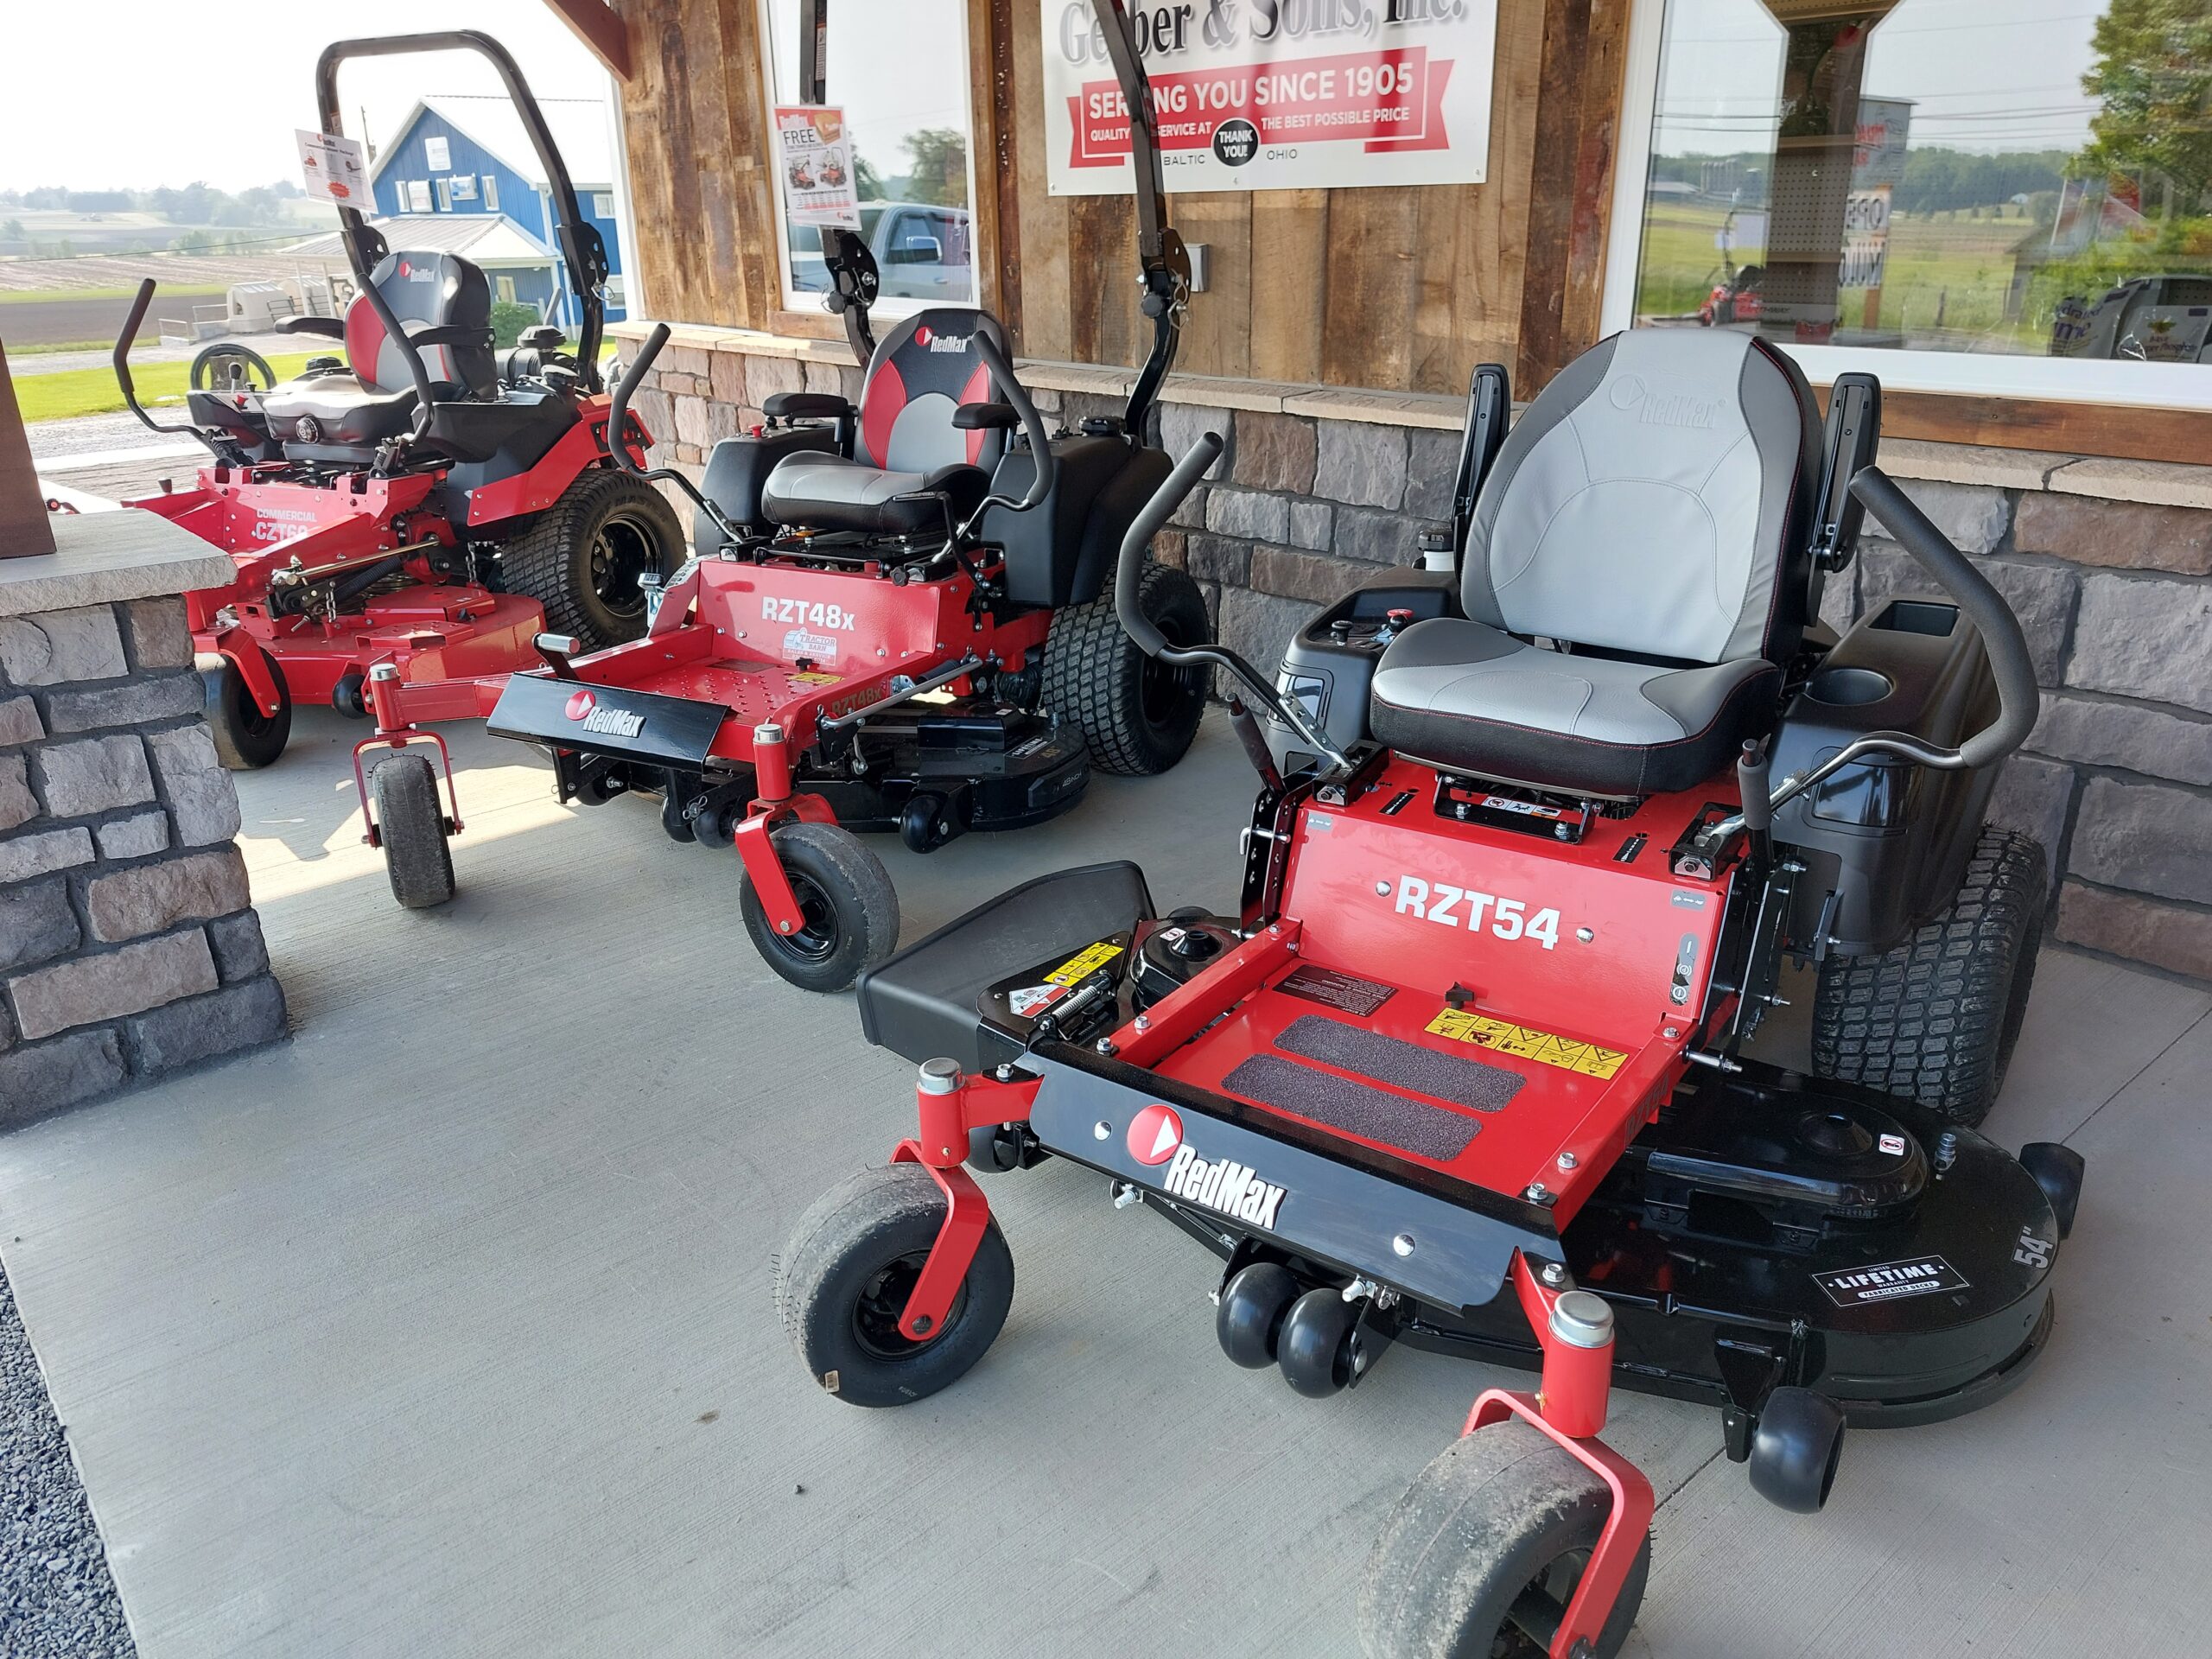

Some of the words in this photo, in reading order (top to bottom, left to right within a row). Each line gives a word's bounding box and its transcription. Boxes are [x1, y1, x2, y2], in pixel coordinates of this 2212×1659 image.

[1059, 0, 1192, 63] Geber
[1090, 85, 1187, 119] SERNG
[1193, 79, 1248, 110] YOU
[1255, 70, 1336, 105] SINCE
[1344, 62, 1414, 98] 1905
[1262, 117, 1281, 130] THE
[1284, 114, 1313, 128] BEST
[1314, 110, 1371, 126] POSSIBLE
[1373, 107, 1410, 122] PRICE
[783, 129, 816, 145] FREE
[1090, 126, 1131, 142] QUALITY
[1198, 122, 1212, 135] AT
[1218, 130, 1253, 143] THANK
[1163, 154, 1205, 166] BALTIC
[1267, 149, 1298, 161] OHIO
[1223, 144, 1248, 158] YOU!
[931, 335, 967, 353] RedMax
[1639, 393, 1714, 429] RedMax
[257, 508, 317, 523] COMMERCIAL
[761, 596, 855, 632] RZT48x
[799, 634, 836, 647] TRACTOR
[809, 644, 827, 652] BARN
[582, 706, 646, 738] RedMax
[1395, 874, 1560, 950] RZT54
[1163, 1143, 1287, 1230] RedMax
[1834, 1263, 1938, 1289] LIFETIME
[1864, 1285, 1909, 1297] FABRICATED
[1910, 1281, 1935, 1291] DECKS
